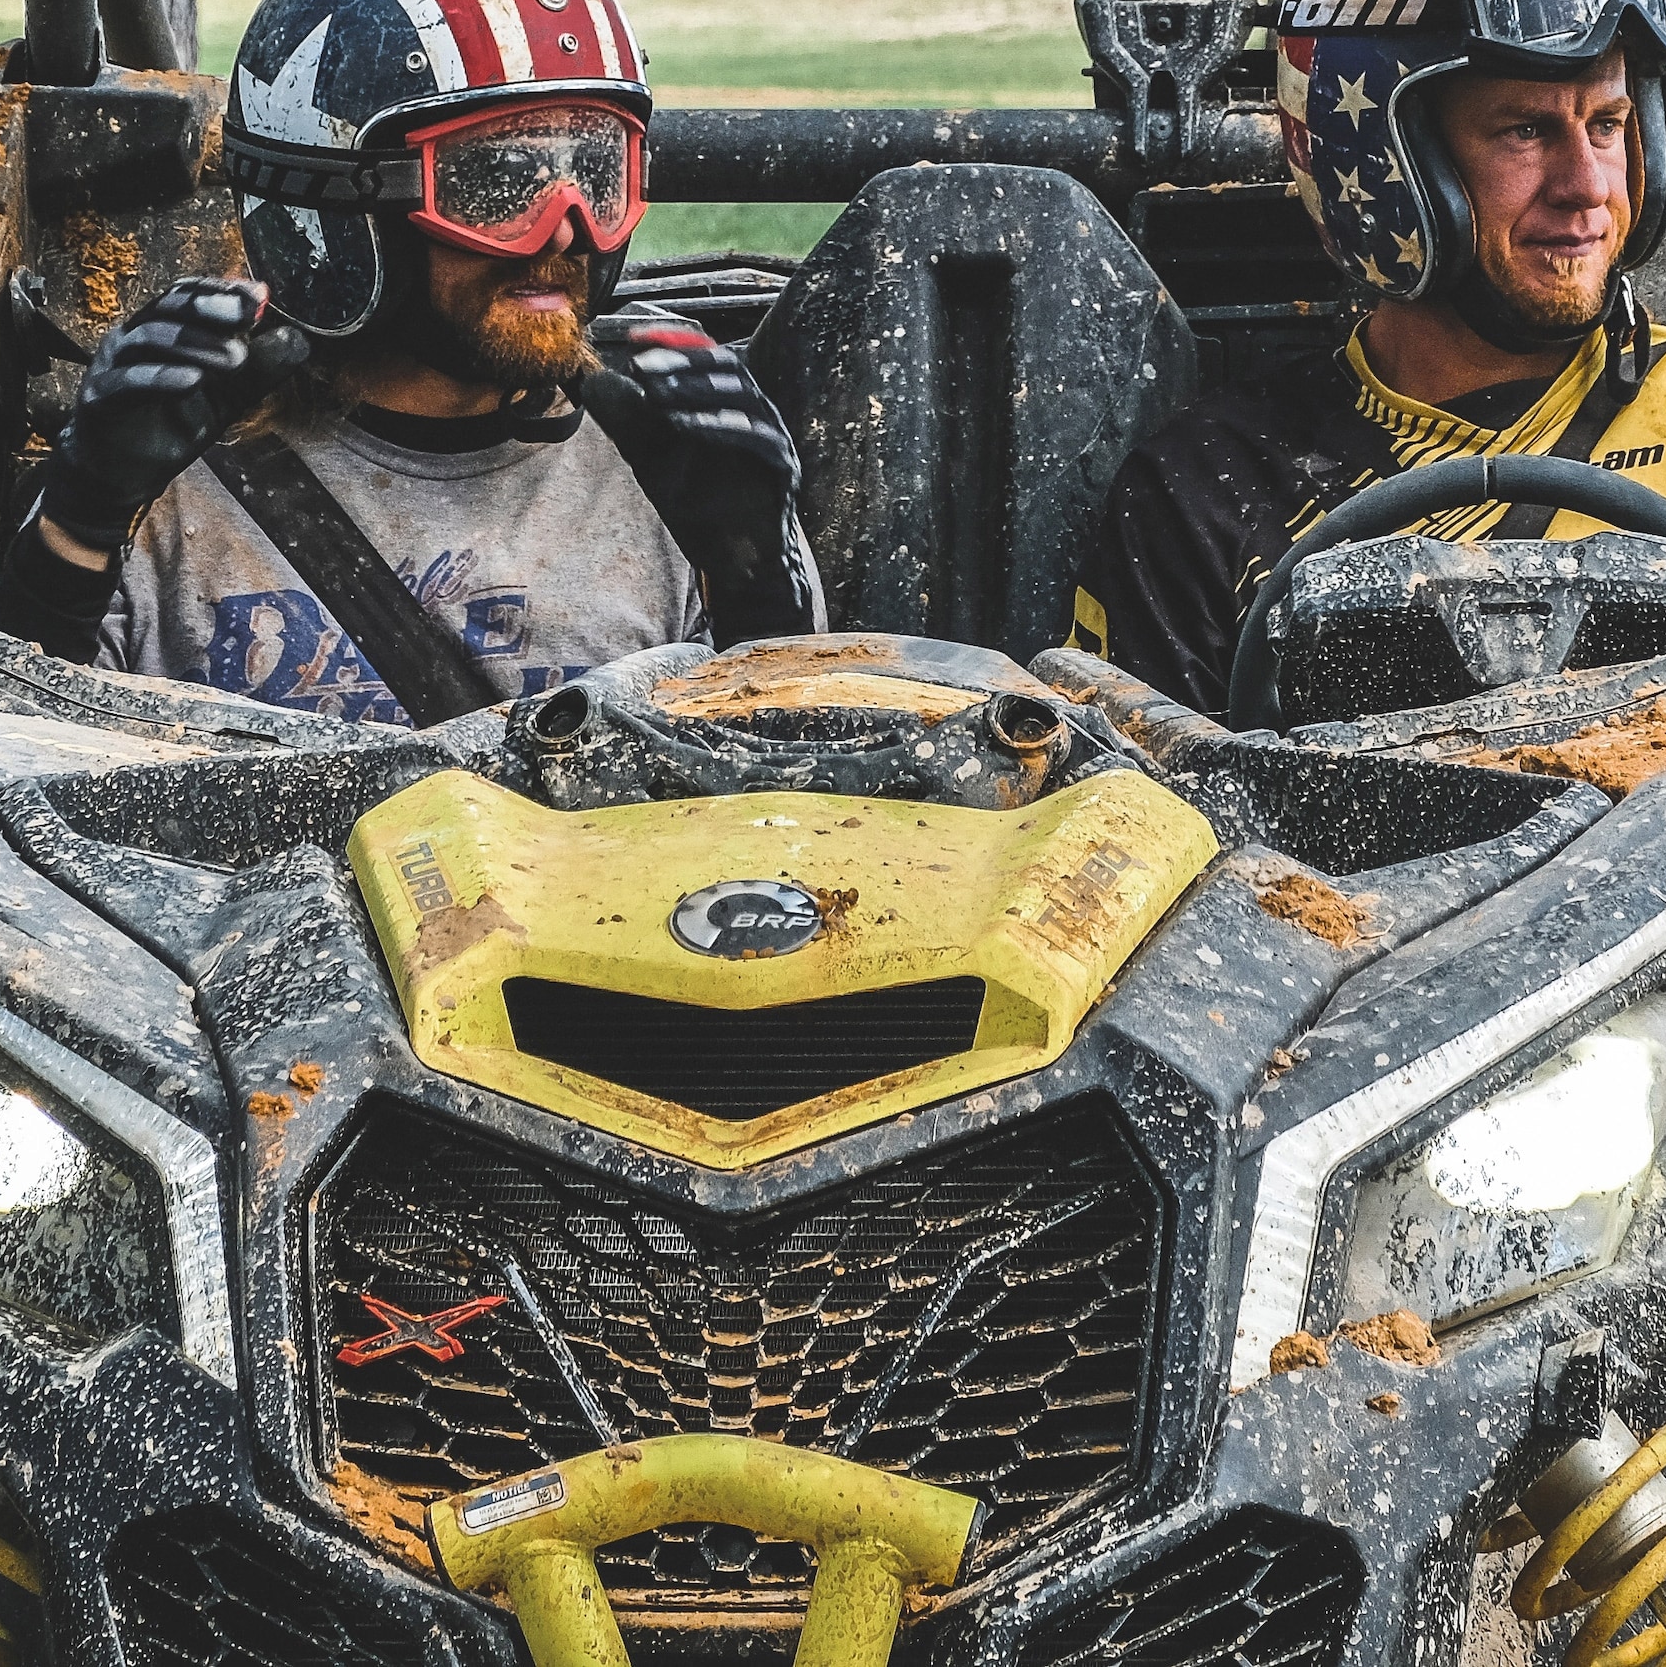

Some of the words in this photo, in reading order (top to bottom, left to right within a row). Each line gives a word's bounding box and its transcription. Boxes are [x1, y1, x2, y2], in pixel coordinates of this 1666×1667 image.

[395, 841, 454, 922] TURB
[730, 912, 815, 930] BRP
[492, 1482, 531, 1503] NOTICE
